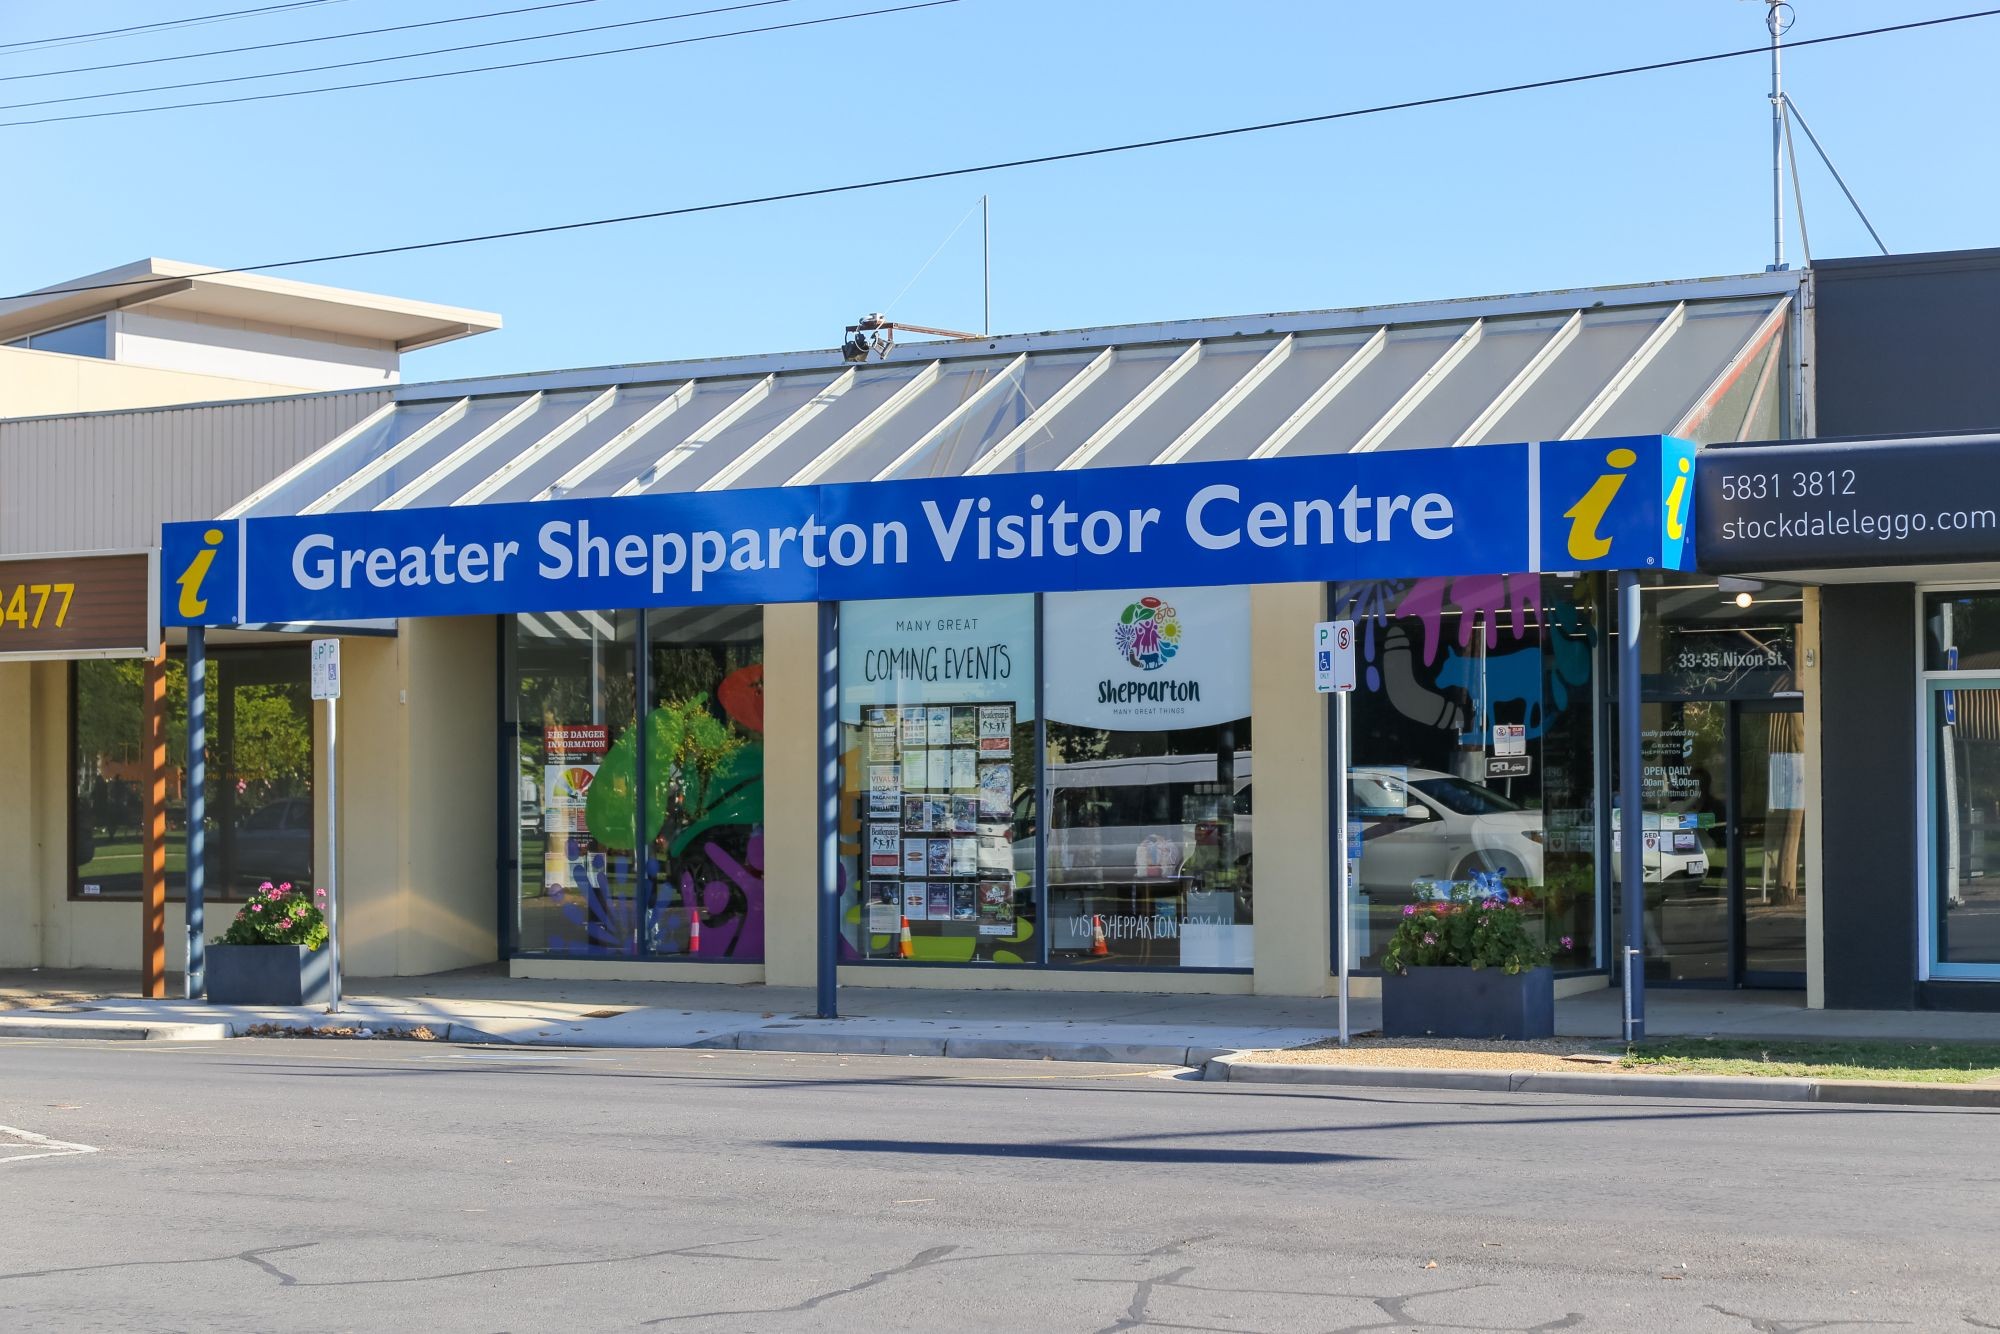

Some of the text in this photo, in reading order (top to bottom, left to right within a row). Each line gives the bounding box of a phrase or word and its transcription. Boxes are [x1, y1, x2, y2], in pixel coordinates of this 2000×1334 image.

[1721, 469, 1856, 501] 5831 3812
[1722, 508, 1996, 540] stockdaleleggo.com
[291, 483, 1454, 594] Greater Shepparton Visitor Centre
[0, 583, 75, 630] 477
[896, 618, 978, 631] MANY GREAT
[1320, 629, 1329, 646] P
[865, 643, 1011, 682] COMING EVENTS
[1679, 651, 1787, 668] 33-35 Nixon St.
[1098, 680, 1200, 704] Shepparton
[1135, 707, 1156, 715] GREAT
[547, 730, 605, 739] FIRE DANGER
[547, 741, 605, 749] INFORMATION
[1644, 766, 1692, 776] OPEN DAILY
[1672, 778, 1700, 787] 5.00pm
